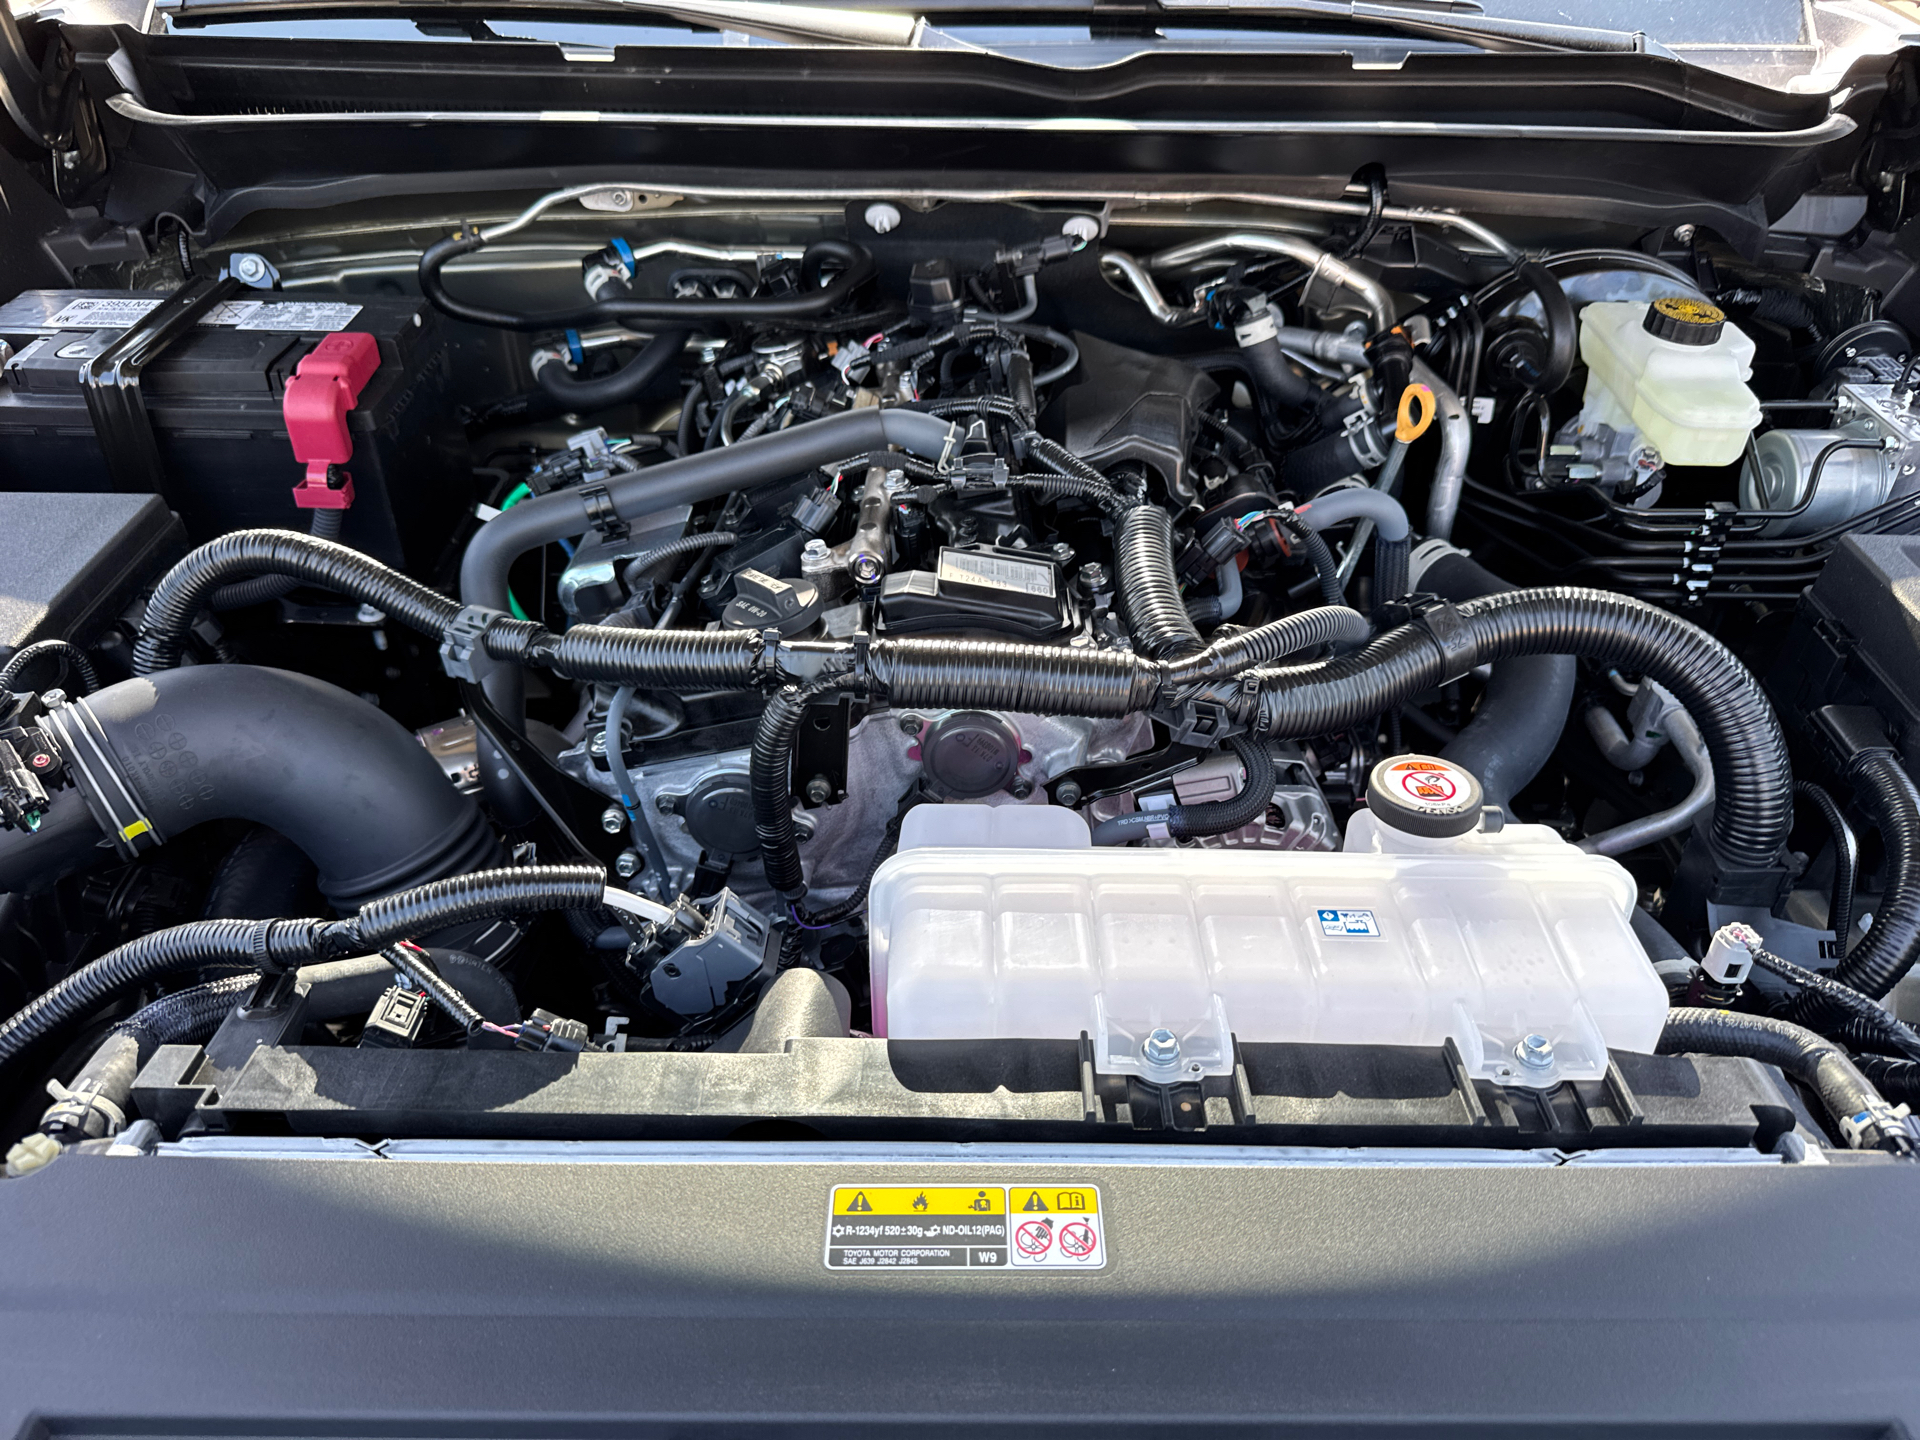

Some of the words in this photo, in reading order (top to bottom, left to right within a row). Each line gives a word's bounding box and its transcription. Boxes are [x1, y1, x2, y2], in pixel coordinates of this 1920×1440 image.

[735, 600, 750, 610] SAE
[748, 604, 767, 617] 0W-20
[1418, 805, 1463, 815] DENSO
[845, 1225, 883, 1238] R-1234yf
[884, 1225, 923, 1238] 520±30g
[942, 1224, 1005, 1238] ND-OIL12(PAG)
[843, 1249, 871, 1257] TOYOTA
[873, 1249, 898, 1257] MOTOR
[900, 1249, 950, 1257] CORPORATION
[978, 1251, 998, 1264] W9
[842, 1257, 857, 1265] SAE
[859, 1257, 875, 1265] J639
[877, 1257, 897, 1265] J2842
